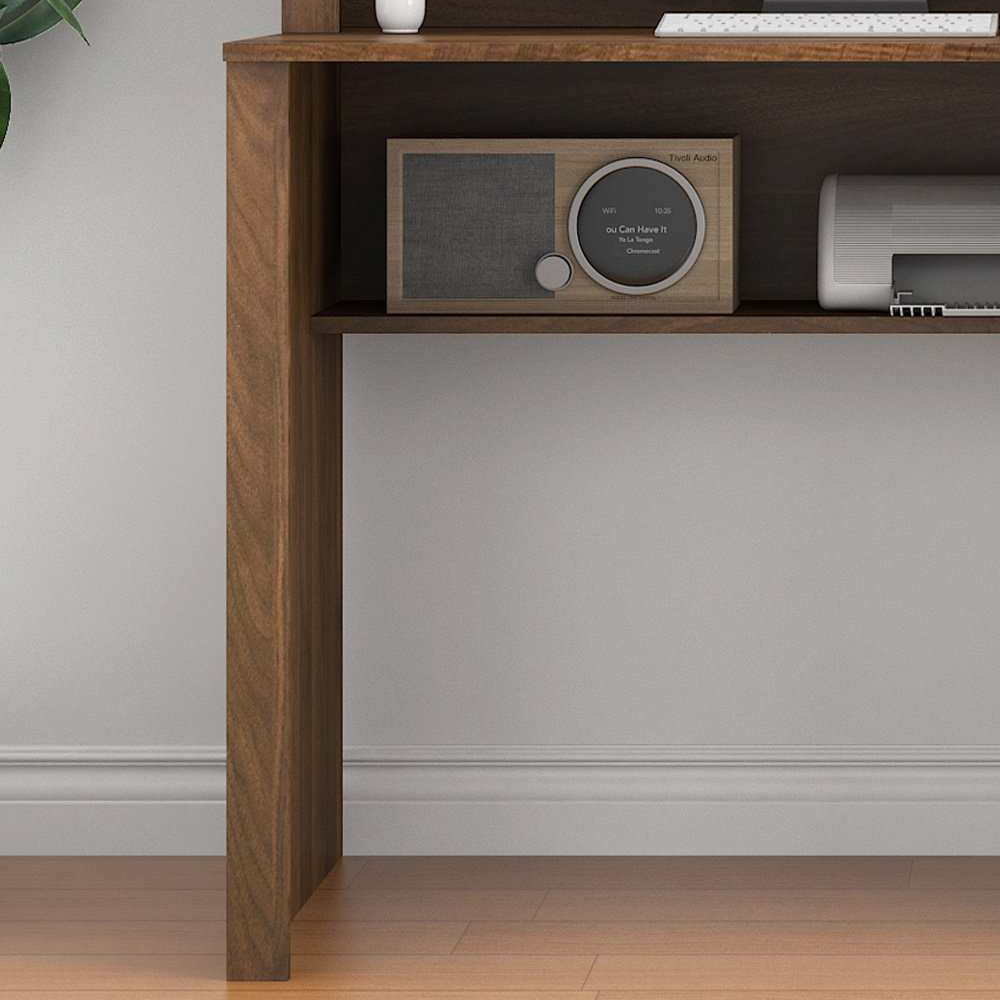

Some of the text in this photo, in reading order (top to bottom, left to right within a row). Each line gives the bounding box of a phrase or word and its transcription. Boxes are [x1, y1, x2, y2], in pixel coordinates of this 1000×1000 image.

[669, 154, 717, 162] Tivoli Audio
[619, 225, 635, 233] Can
[638, 225, 659, 233] Have
[661, 225, 668, 233] It
